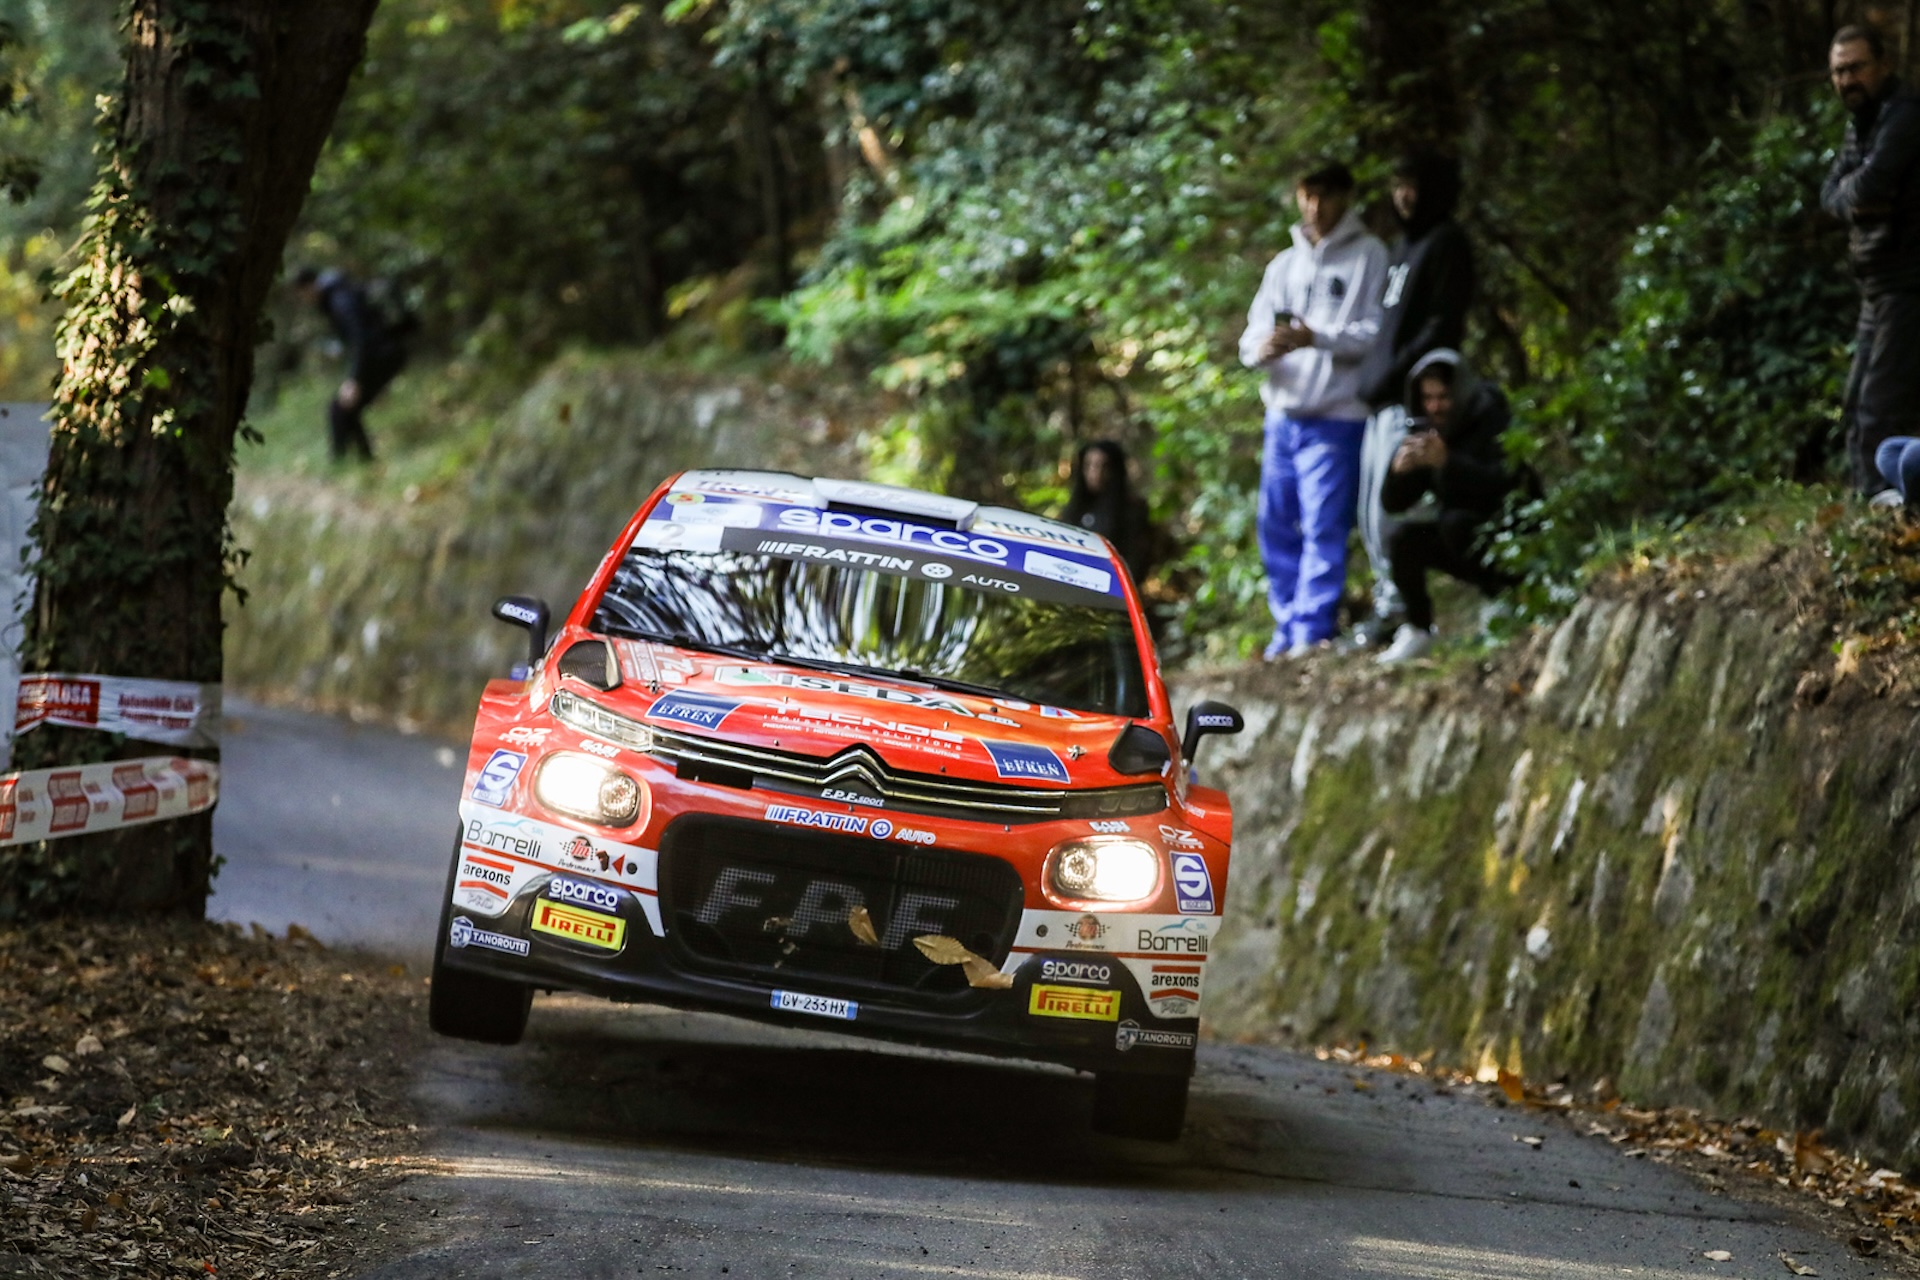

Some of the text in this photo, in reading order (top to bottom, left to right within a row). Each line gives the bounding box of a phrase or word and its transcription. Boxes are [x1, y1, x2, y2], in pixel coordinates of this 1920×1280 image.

[657, 523, 686, 546] 2
[777, 508, 1008, 564] sparco
[983, 519, 1088, 548] TRONY
[786, 542, 1021, 592] FRATTIN AUTO
[871, 729, 962, 751] SOLUTIONS
[466, 818, 542, 859] Borrelli
[782, 807, 936, 845] FRATTIN AUTO
[463, 863, 512, 885] arexons
[549, 877, 618, 910] sparco
[540, 905, 616, 943] PIRELLI
[472, 931, 527, 953] TANOROUTE
[1137, 929, 1208, 953] Borrelli
[1042, 960, 1111, 983] sparco
[1151, 972, 1200, 988] arexons
[1037, 989, 1113, 1016] PIRELLI
[1139, 1032, 1192, 1046] TANOROUTE
